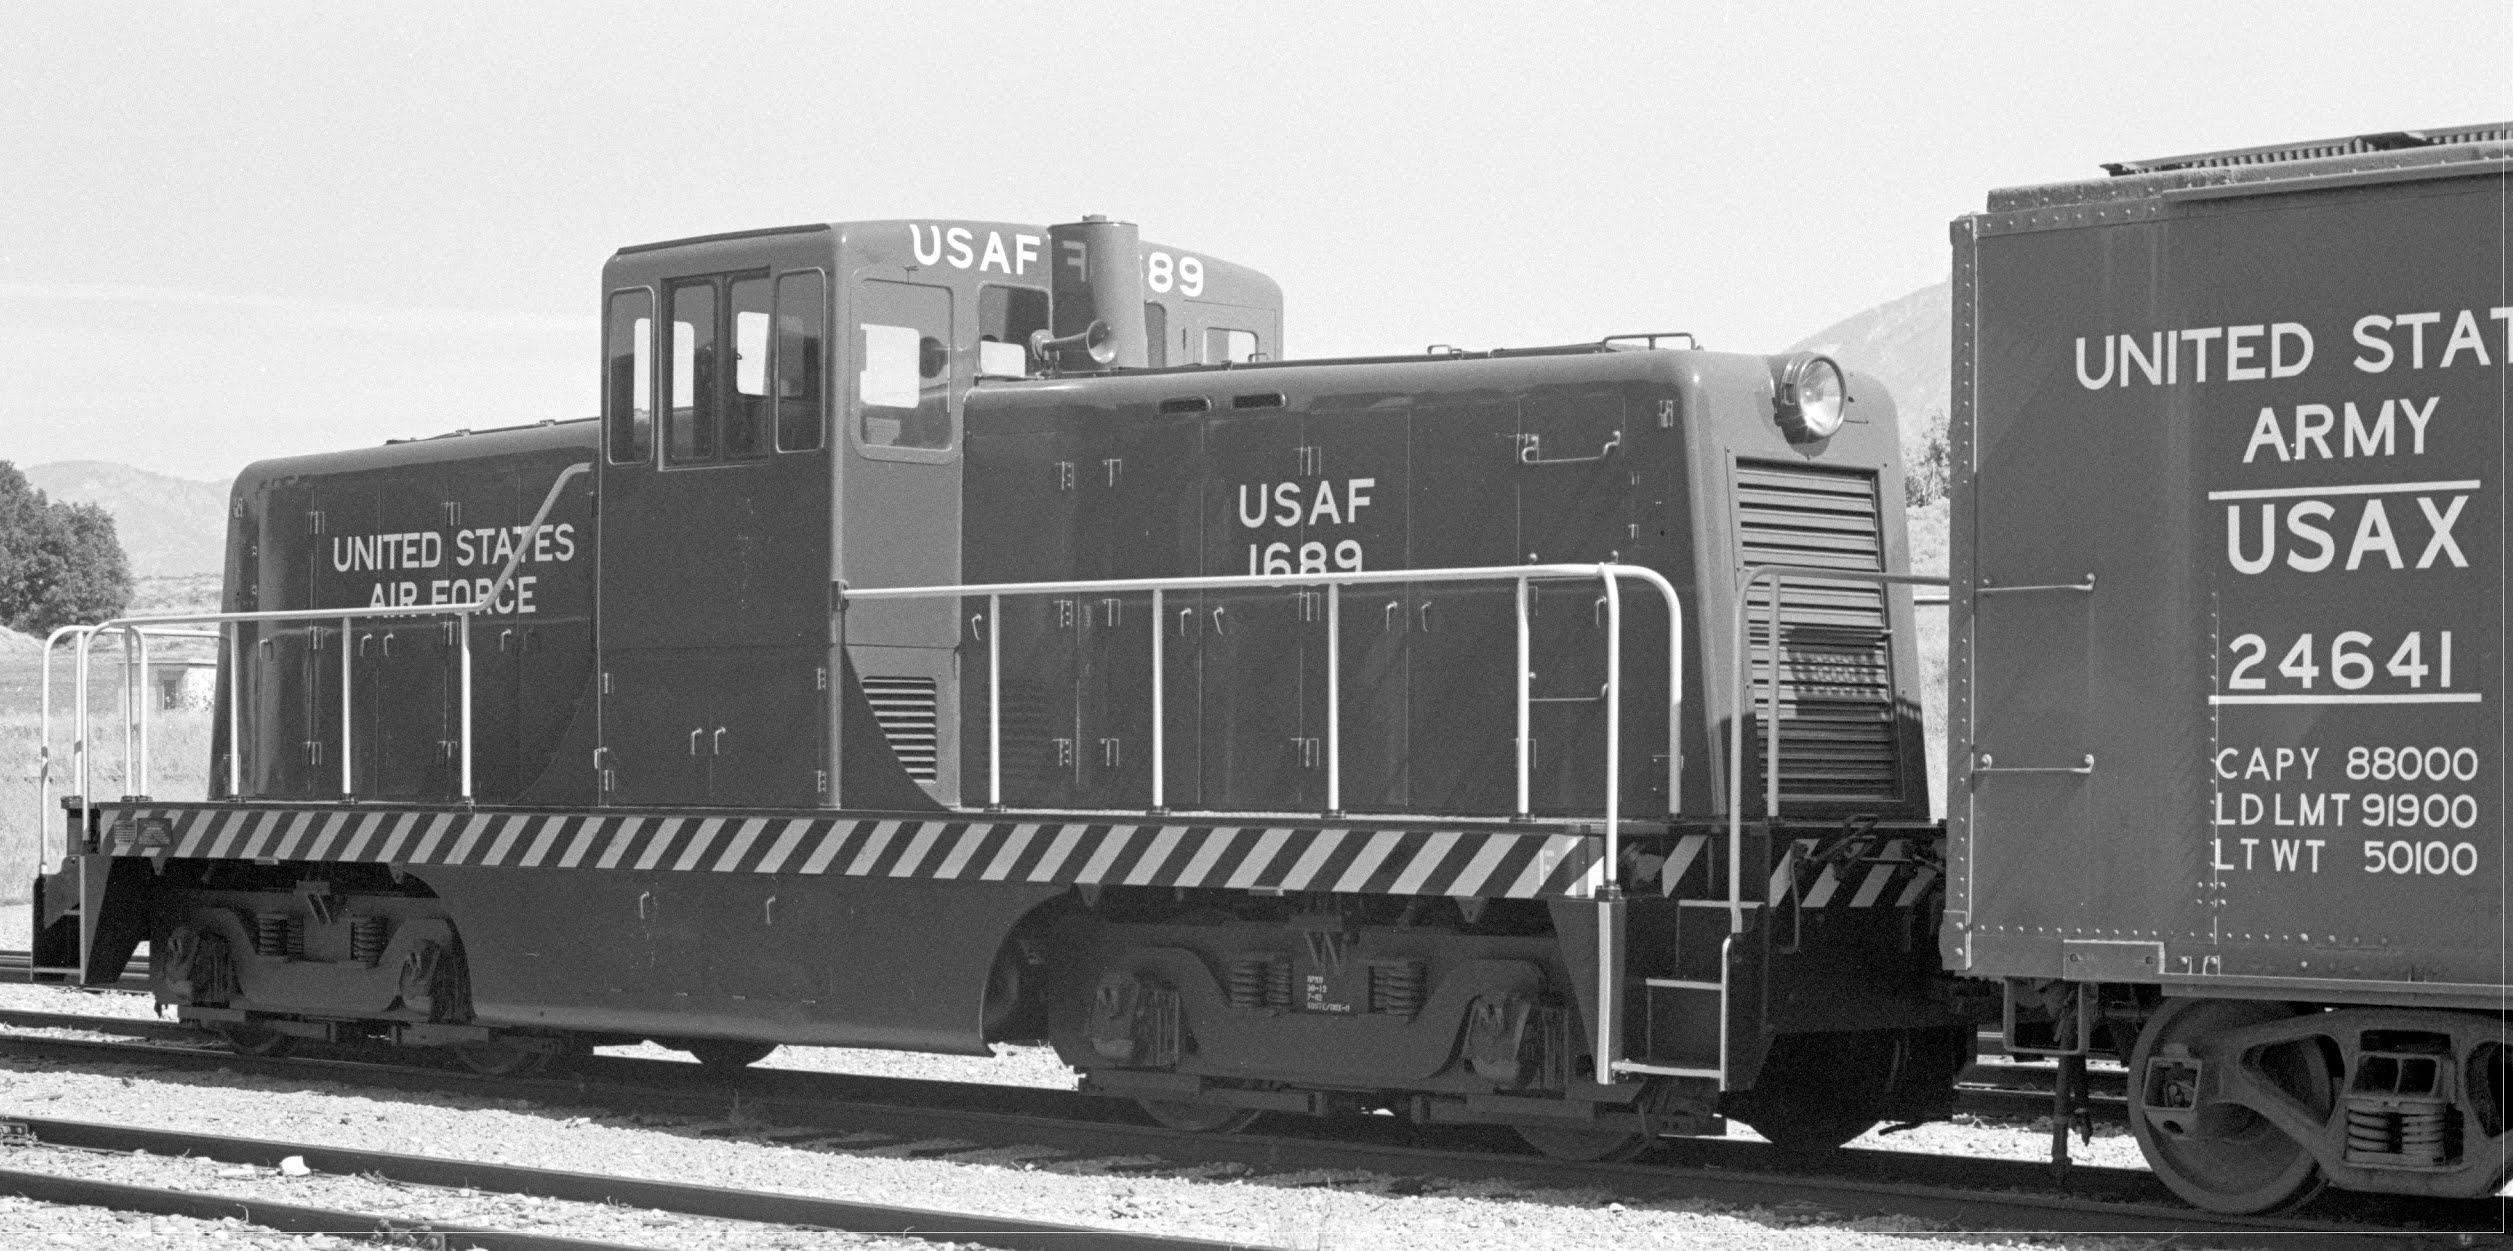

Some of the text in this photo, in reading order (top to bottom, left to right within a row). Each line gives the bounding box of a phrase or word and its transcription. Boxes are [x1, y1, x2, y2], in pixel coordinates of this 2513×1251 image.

[909, 223, 1204, 297] USAF 89
[2075, 321, 2315, 391] UNITED
[2242, 396, 2440, 464] ARMY
[1239, 477, 1376, 529] USAF
[333, 523, 575, 572] UNITED STATES
[2227, 494, 2470, 575] USAX
[1249, 539, 1363, 587] 1689
[367, 576, 537, 618] AIR FORCE
[2228, 630, 2452, 690] 24641
[2215, 746, 2479, 782] CAPY 88000
[2215, 792, 2478, 829] LD LMT 91900
[2214, 838, 2478, 877] LT WT 50100
